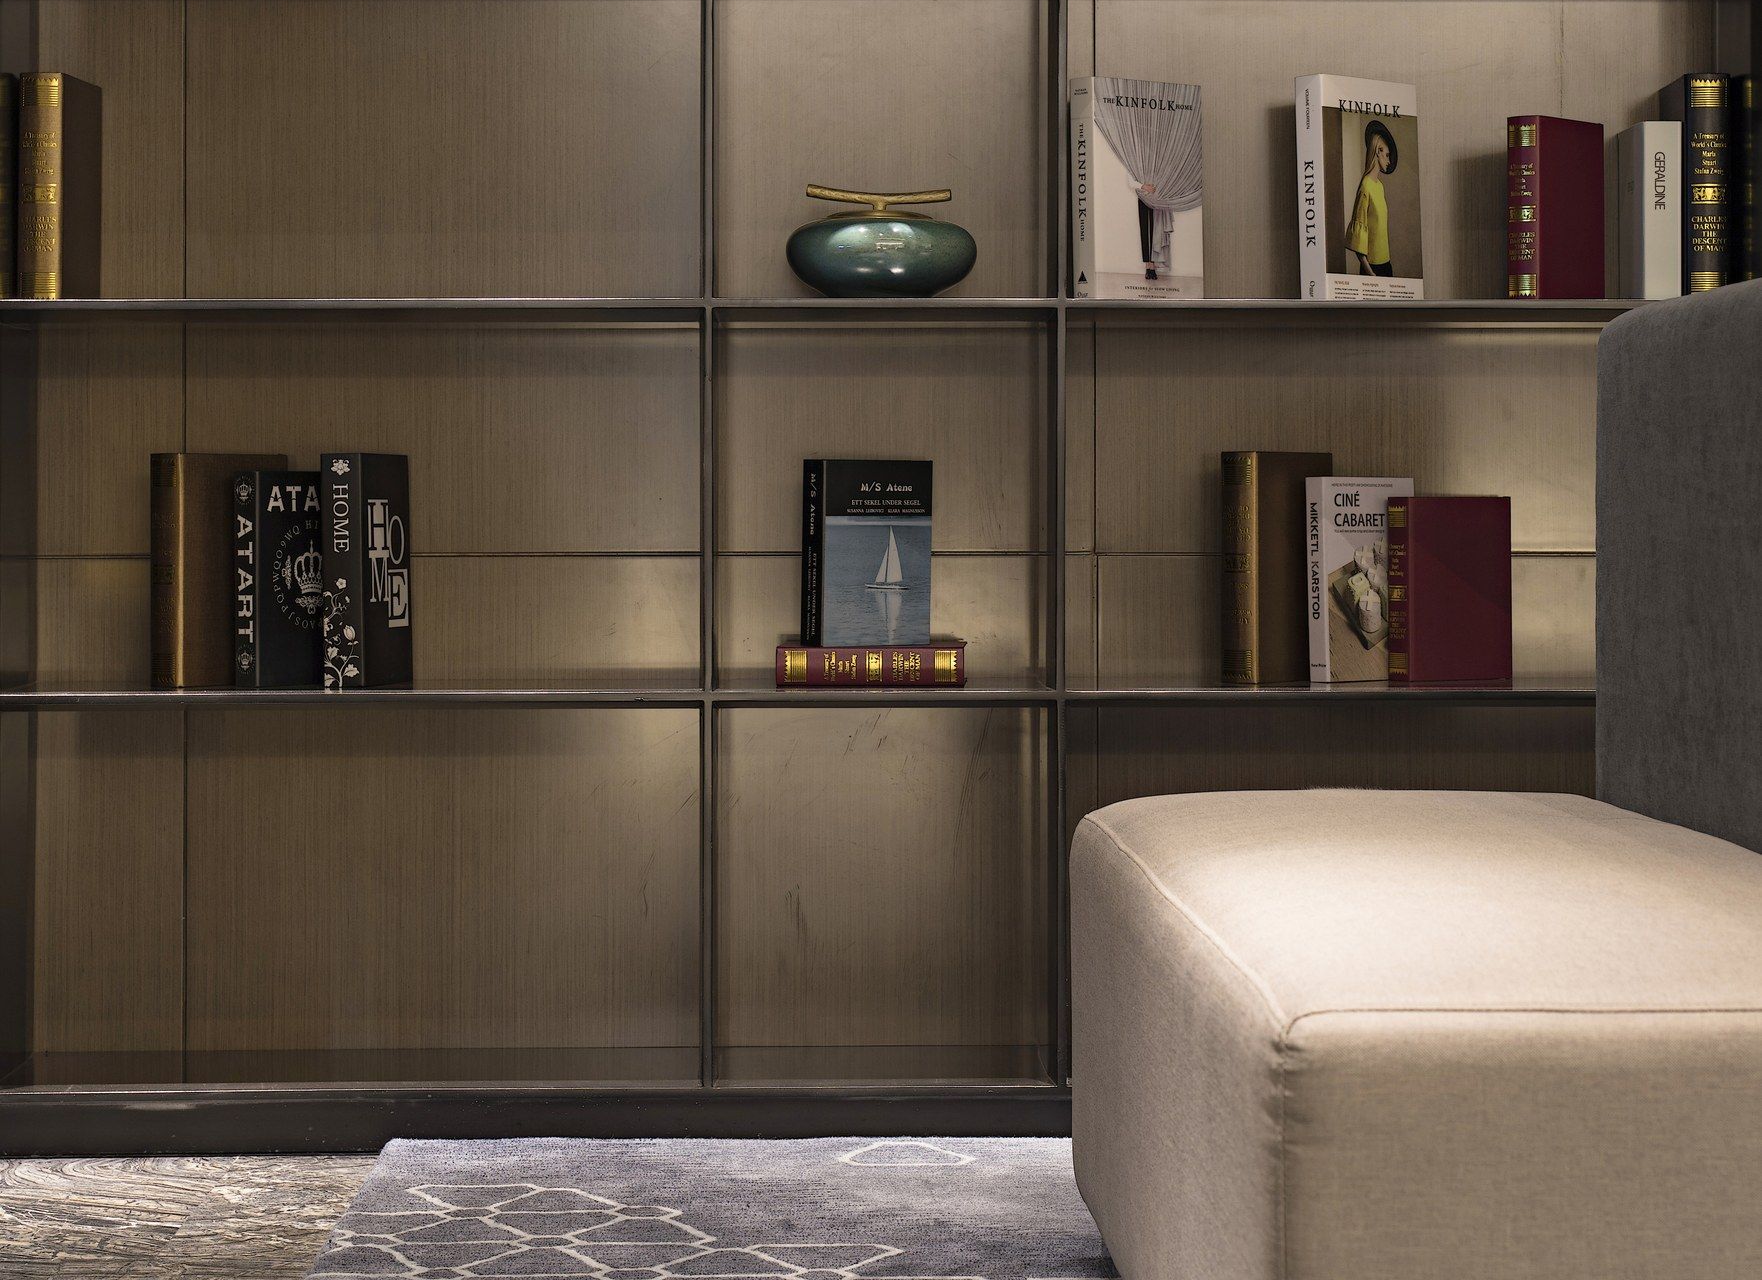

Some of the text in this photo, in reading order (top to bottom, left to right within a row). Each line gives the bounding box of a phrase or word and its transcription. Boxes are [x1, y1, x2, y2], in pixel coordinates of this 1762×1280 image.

[1115, 95, 1175, 111] KINFOLK
[1339, 99, 1400, 118] KINFOLK
[1078, 139, 1087, 220] KINFOLK
[1654, 151, 1666, 210] GERALDINE
[1304, 160, 1316, 248] KINFOLK
[861, 481, 913, 493] M/S Atene
[1334, 491, 1360, 507] CINÉ
[332, 483, 350, 553] HOME
[1334, 513, 1385, 527] CABARET
[237, 514, 254, 644] ATART
